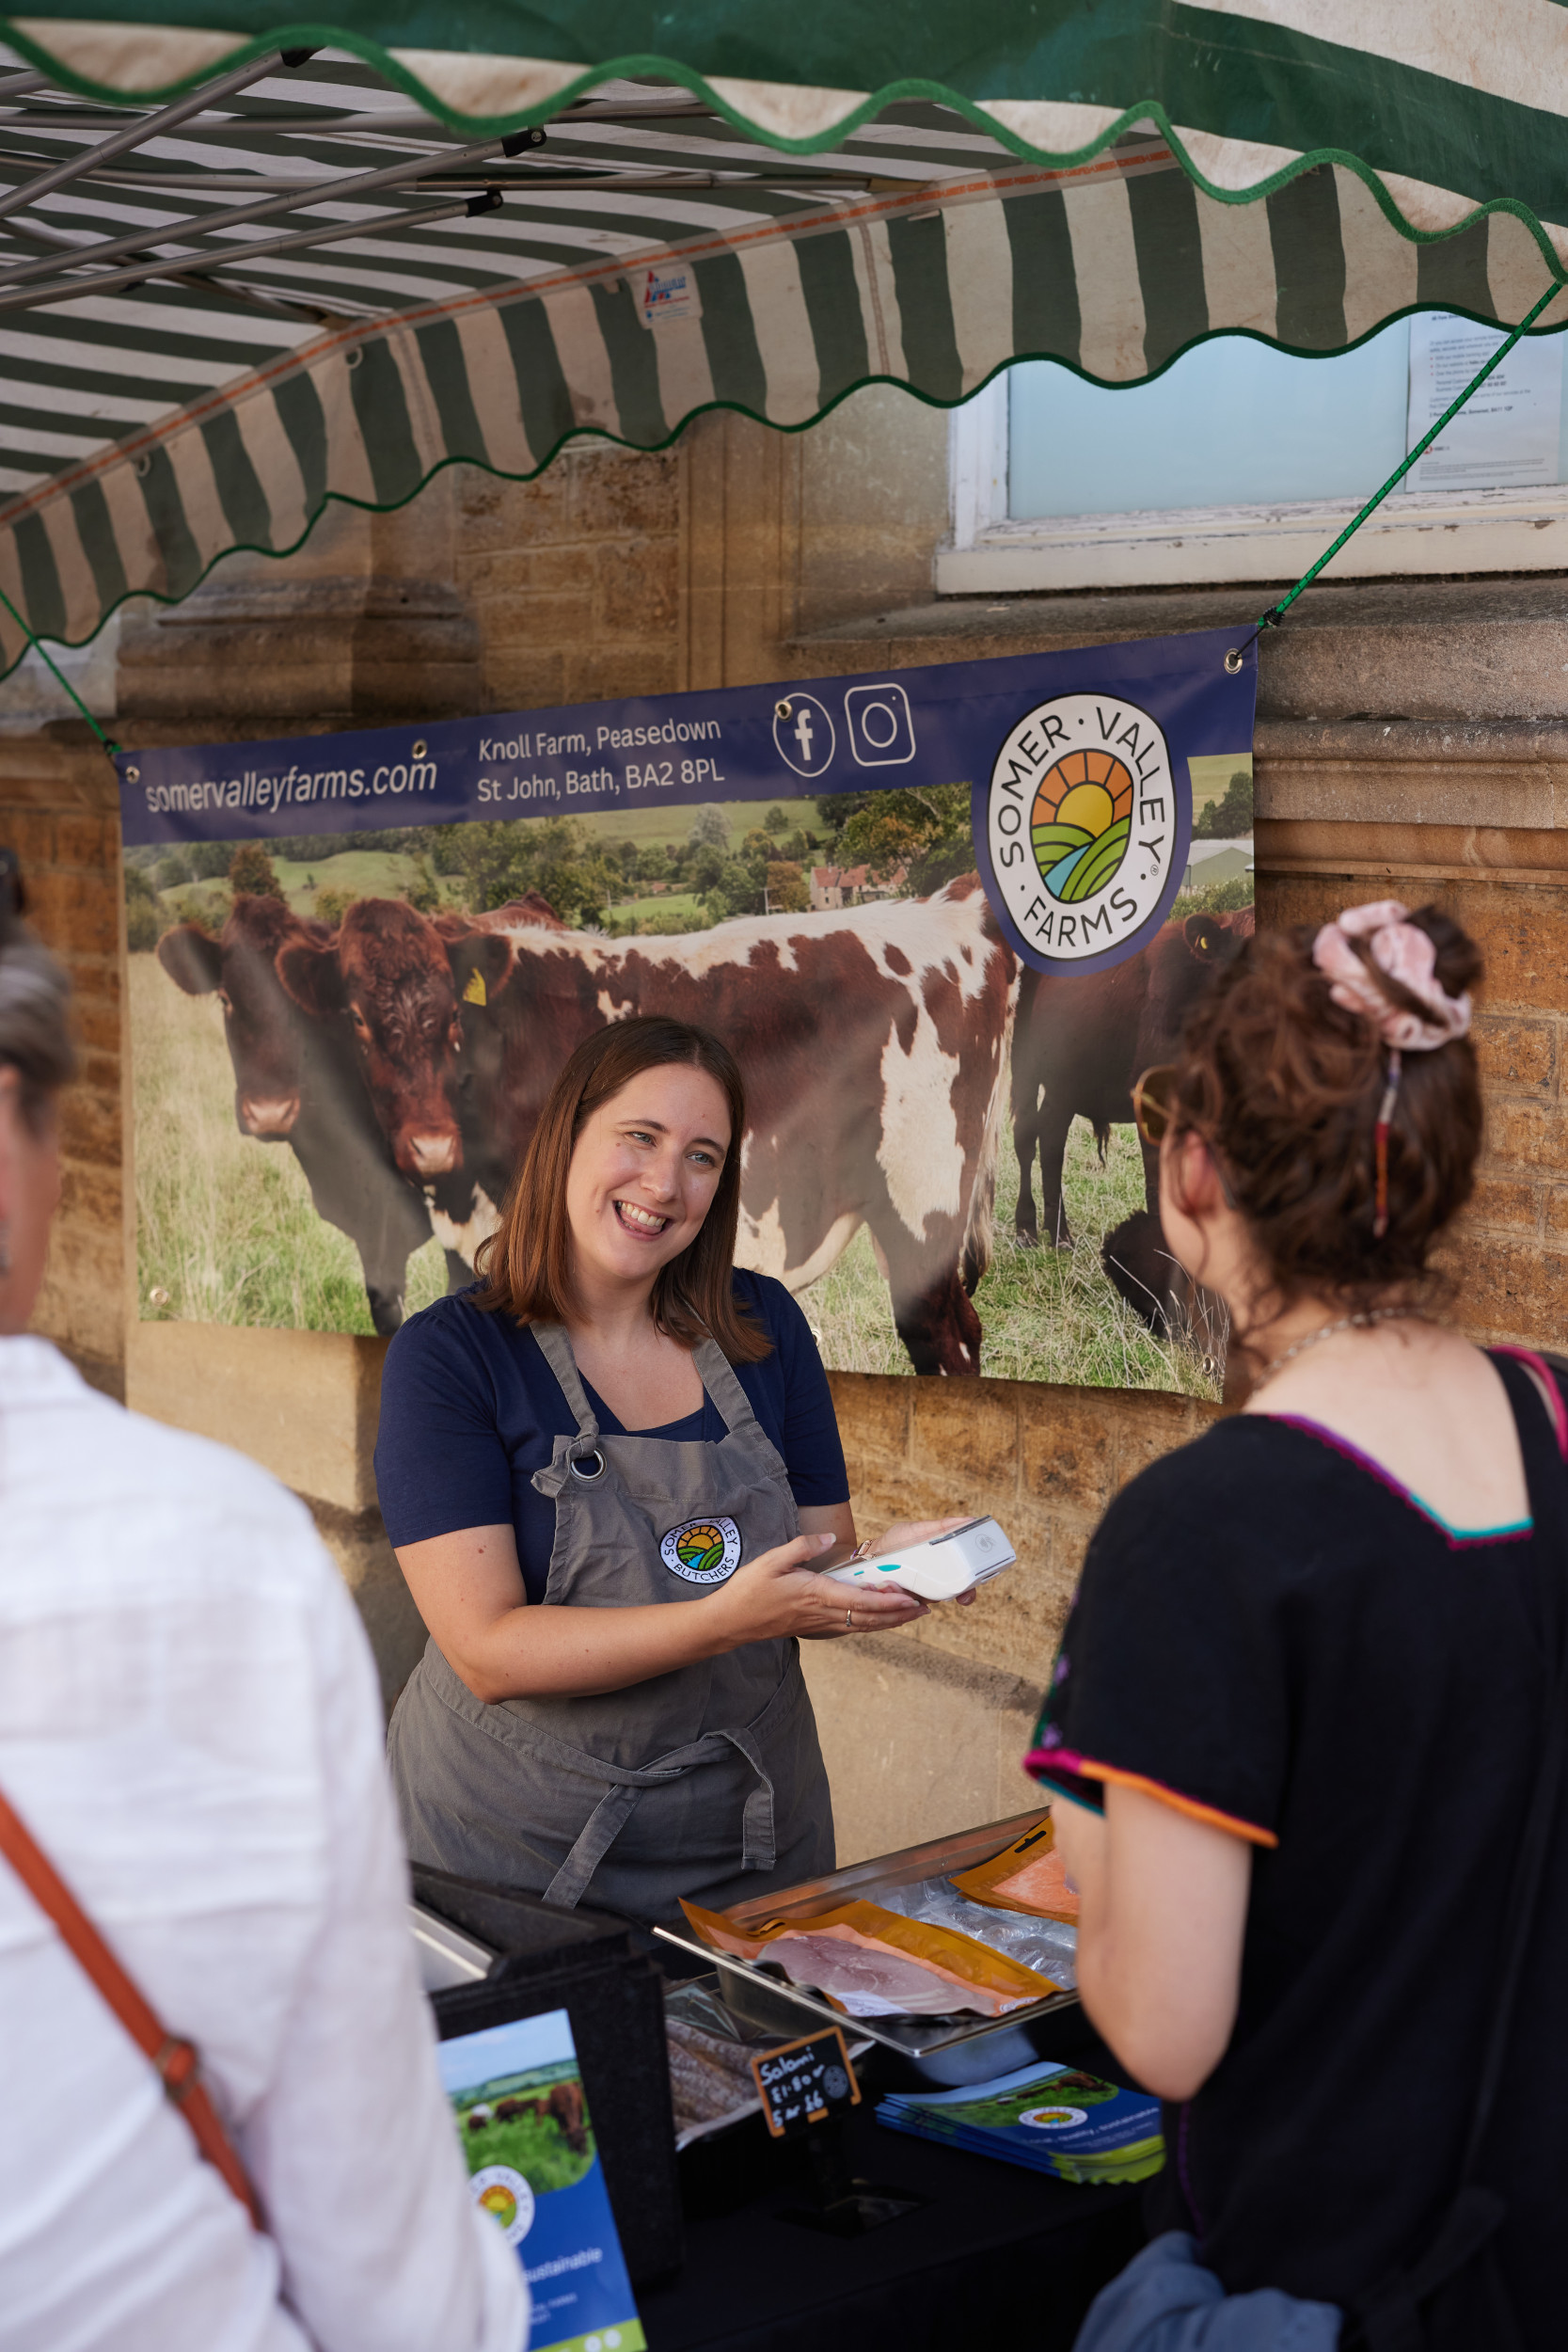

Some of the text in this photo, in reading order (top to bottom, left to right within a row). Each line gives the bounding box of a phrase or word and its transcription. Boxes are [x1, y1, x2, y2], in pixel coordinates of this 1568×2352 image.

[478, 718, 721, 762] Knoll Farm, Peasedown
[145, 762, 437, 813] somervalleyfarms.com
[477, 758, 725, 802] St John, Bath, BA2 8PL
[998, 707, 1165, 867] SOMER VALLEY
[1023, 886, 1138, 947] FARMS
[708, 1518, 738, 1546] ALLEY
[673, 1556, 735, 1581] BUTCHERS
[761, 2045, 816, 2086] Salami
